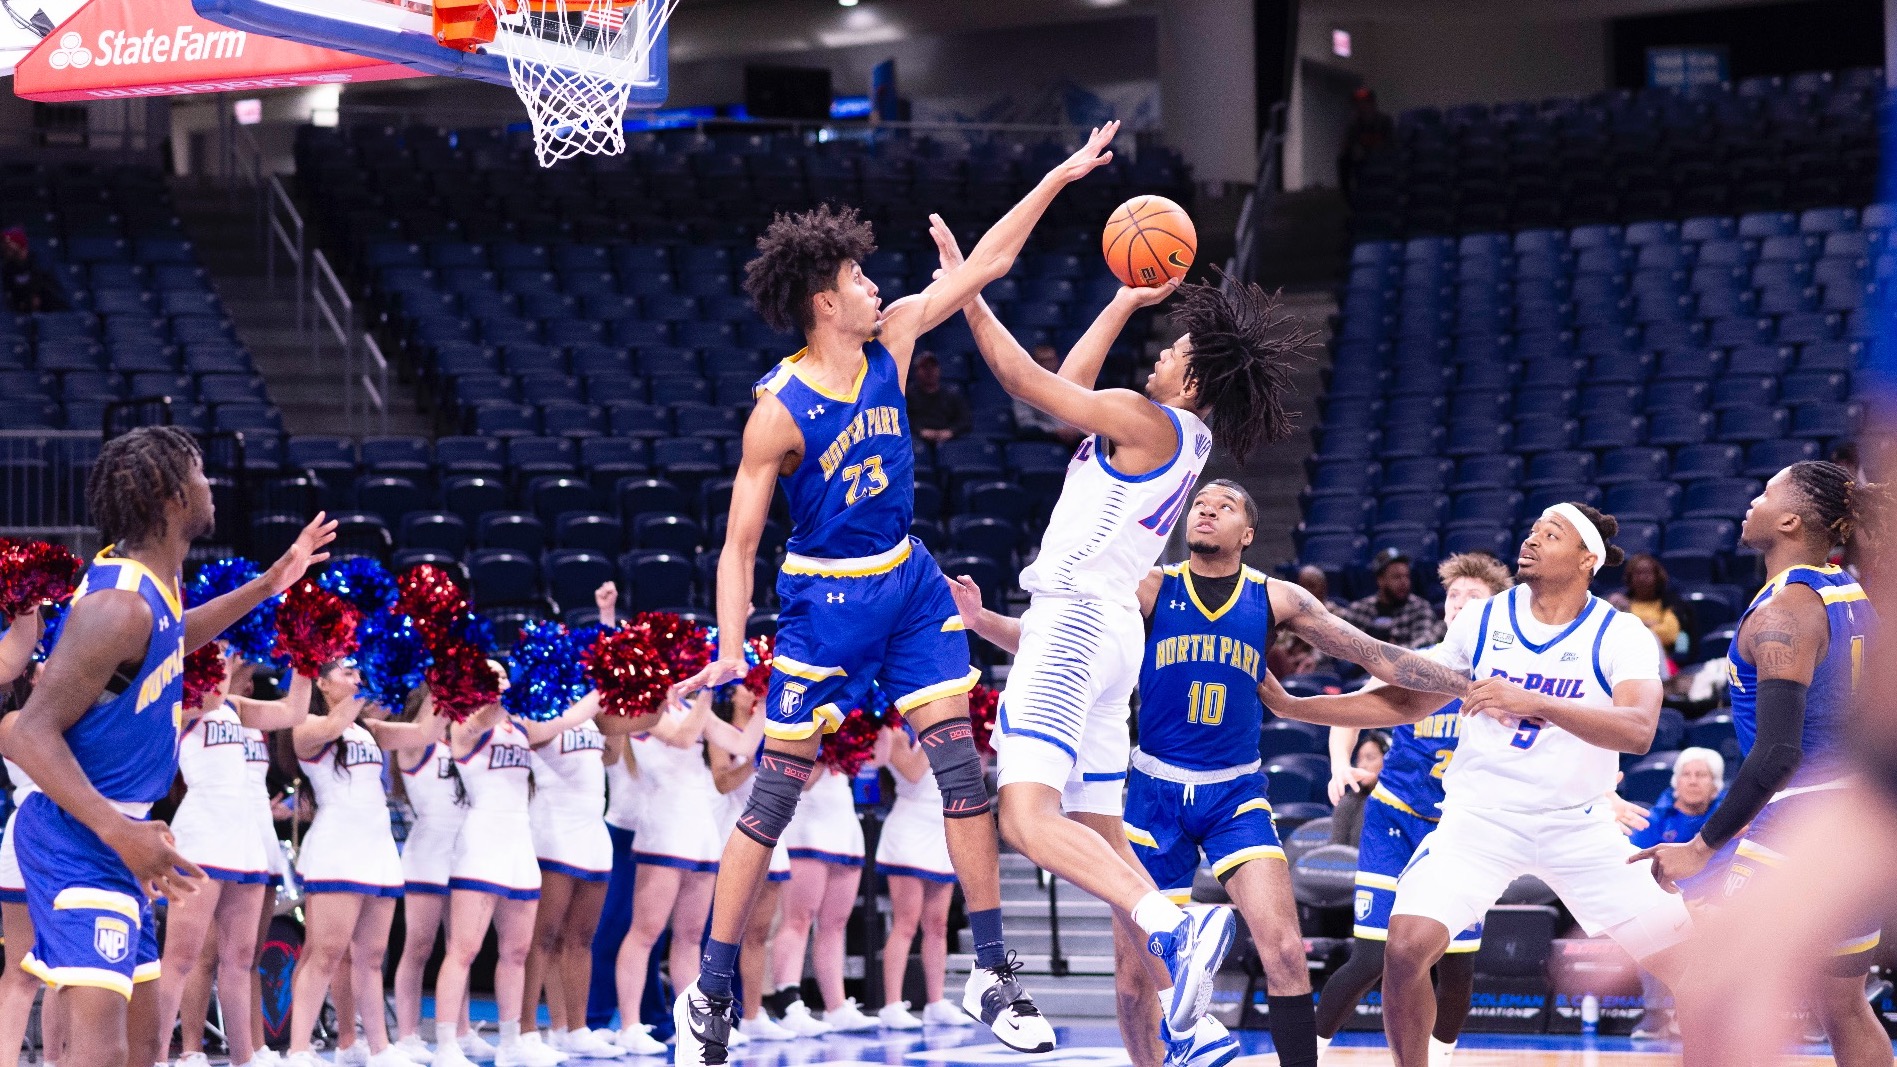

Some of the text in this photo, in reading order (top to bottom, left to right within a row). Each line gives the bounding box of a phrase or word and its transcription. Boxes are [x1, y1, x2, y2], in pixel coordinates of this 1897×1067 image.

[842, 454, 889, 508] 23
[1156, 634, 1216, 671] NORTH
[1490, 667, 1585, 699] PAUL
[1187, 680, 1227, 726] 10
[98, 929, 126, 960] NP
